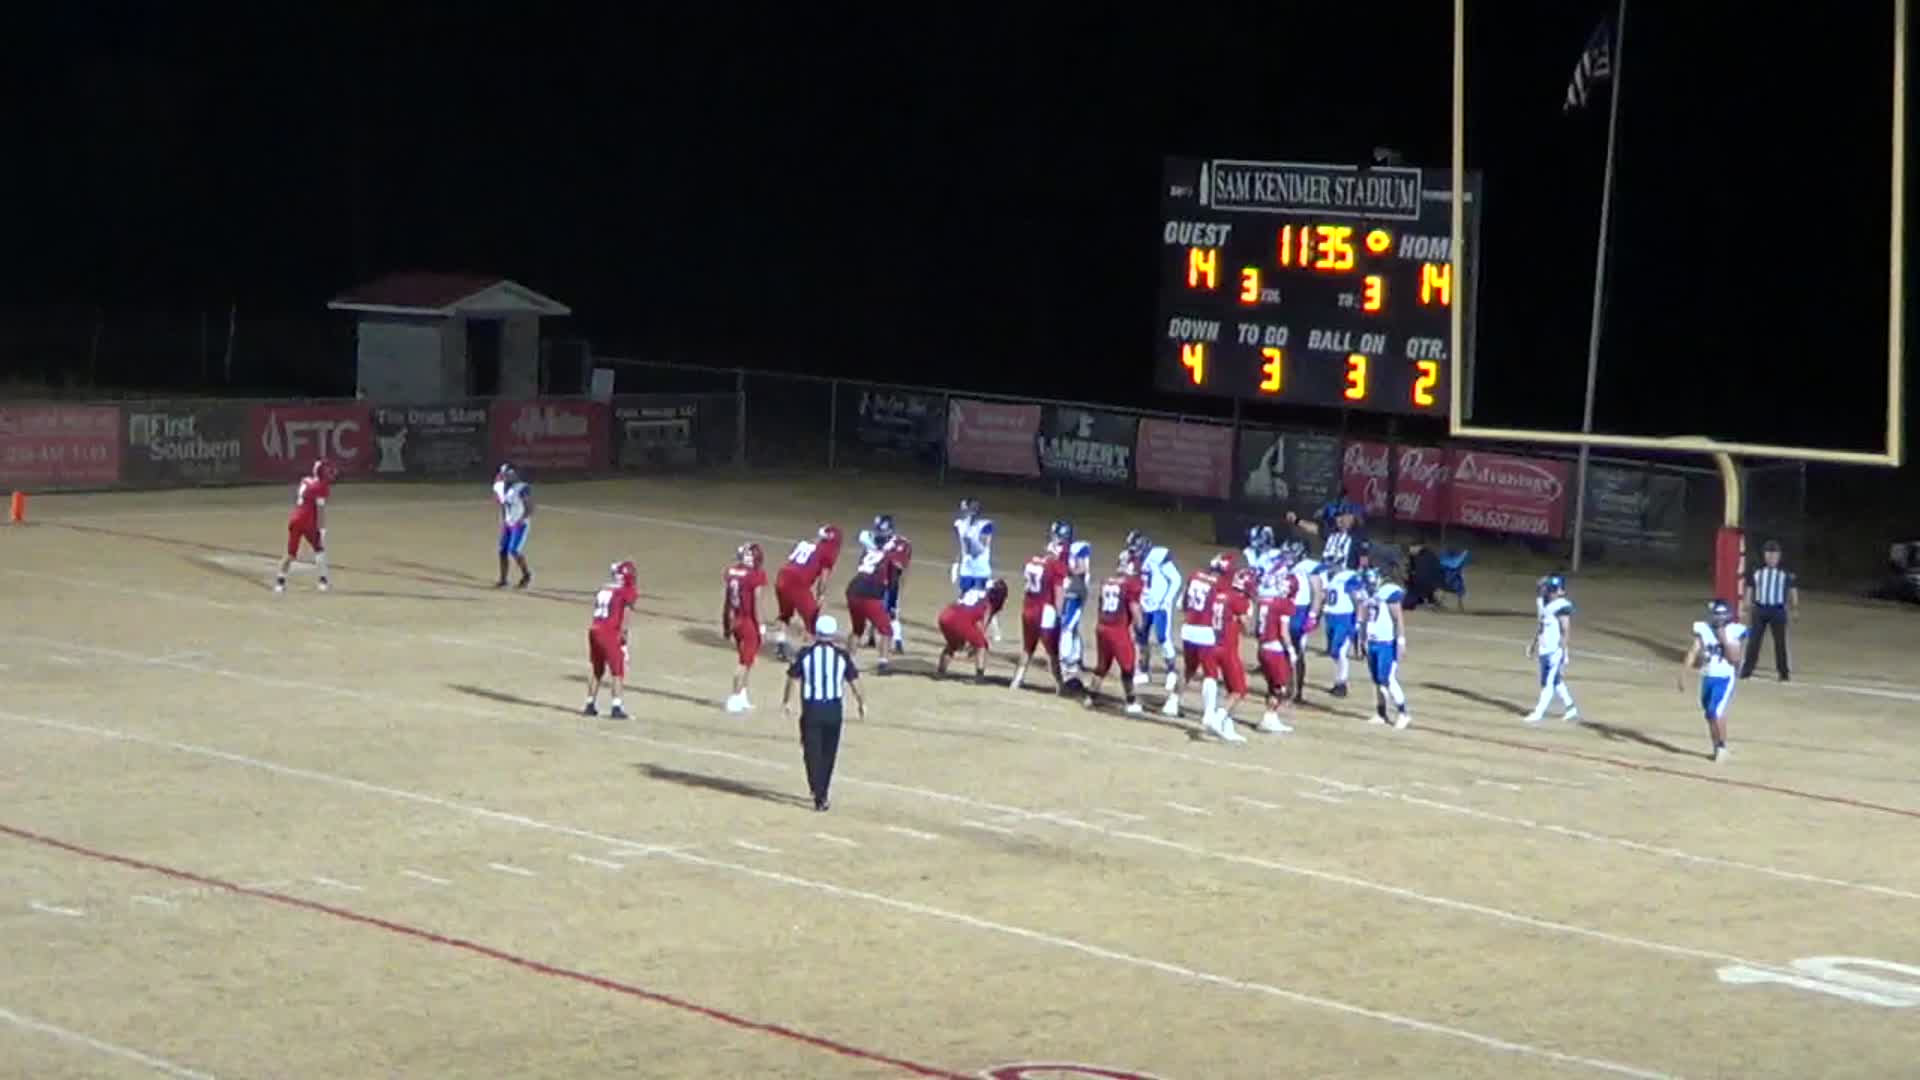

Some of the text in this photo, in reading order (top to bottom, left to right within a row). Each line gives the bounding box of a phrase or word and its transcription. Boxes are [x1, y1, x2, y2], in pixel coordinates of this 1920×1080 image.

[1216, 170, 1416, 209] SAM KENIMER STADIUM
[1164, 221, 1231, 247] GUEST
[1398, 234, 1452, 260] HOM
[1188, 247, 1216, 289] 14
[1240, 267, 1259, 303] 3
[1421, 262, 1450, 305] 14
[1363, 275, 1381, 310] 3
[1168, 318, 1220, 342] DOWN
[1238, 323, 1289, 347] TO GO
[1308, 329, 1387, 355] BALL ON
[1182, 342, 1203, 385] 4
[1260, 347, 1281, 391] 3
[1344, 353, 1366, 400] 3
[1414, 359, 1437, 406] 2
[284, 419, 361, 459] FTC
